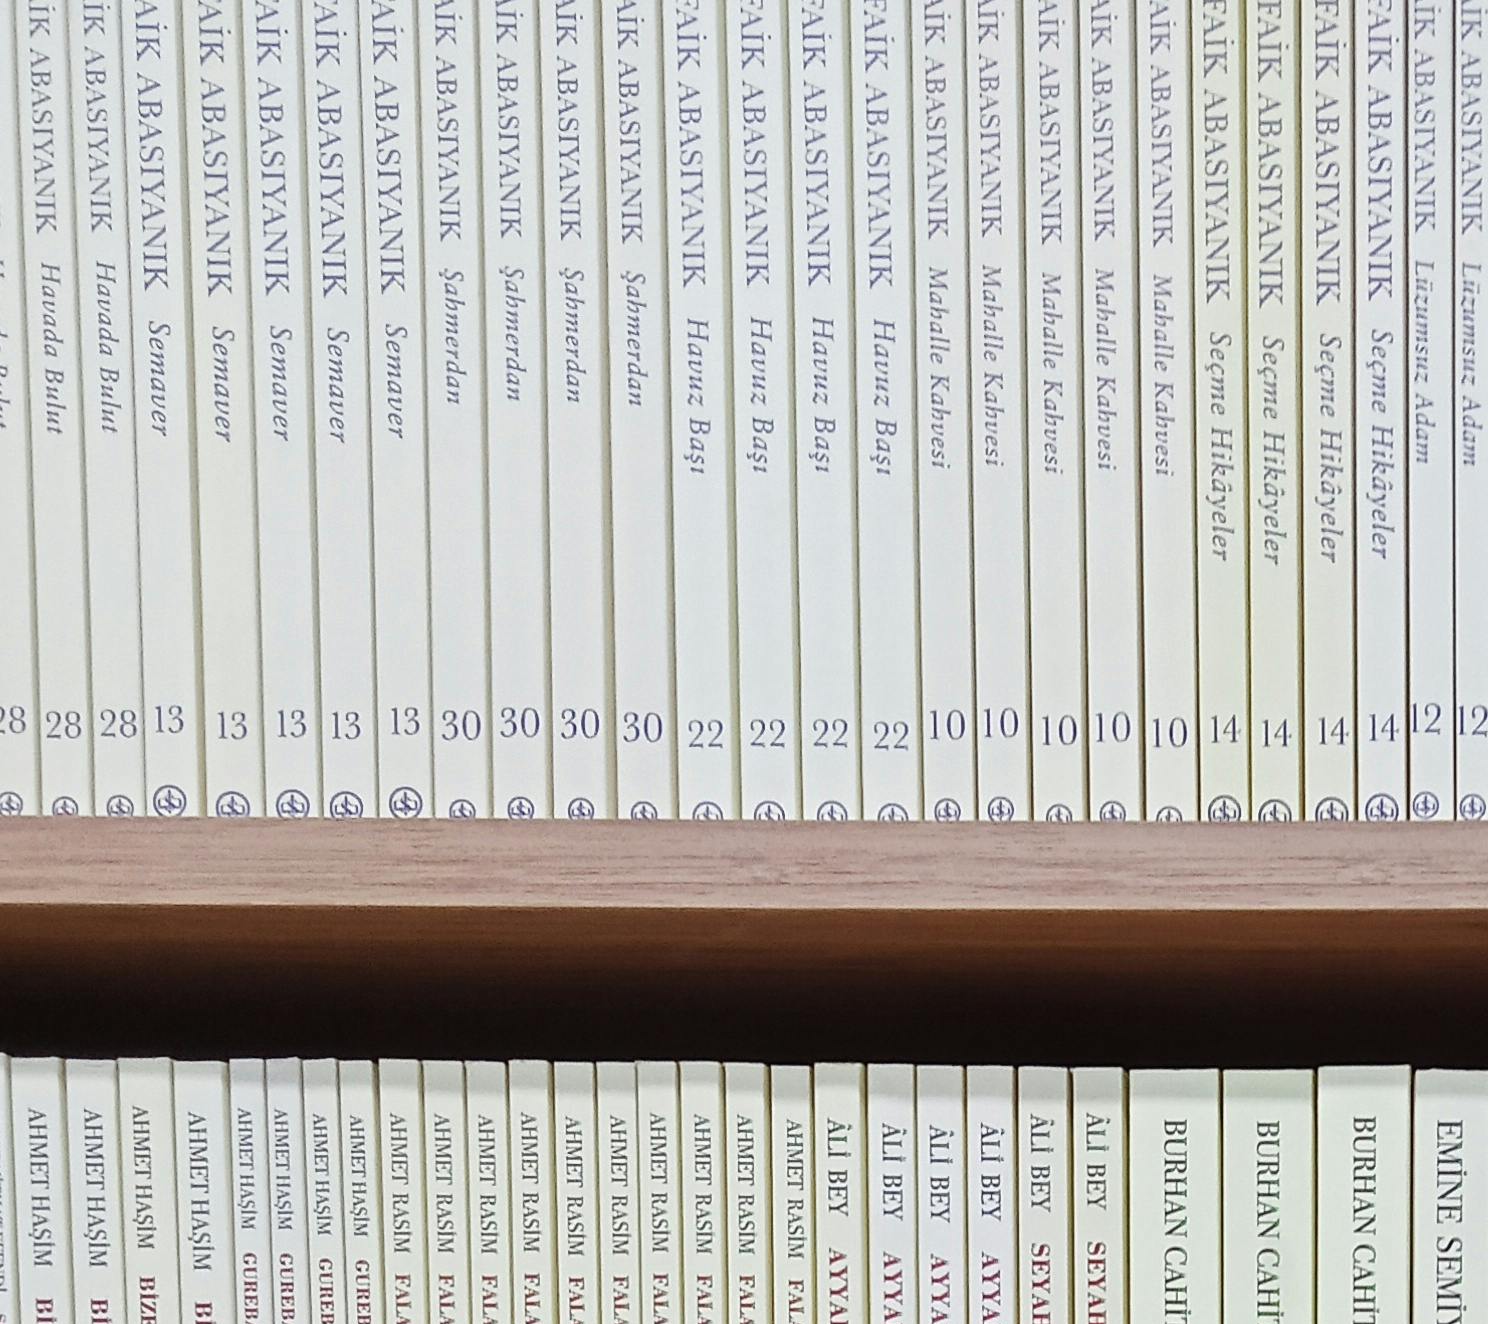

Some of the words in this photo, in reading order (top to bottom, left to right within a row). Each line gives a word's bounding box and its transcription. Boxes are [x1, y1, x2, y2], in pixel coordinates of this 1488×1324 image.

[29, 55, 58, 235] ABASIYANIK
[435, 54, 462, 243] ABASIYANIK
[1257, 91, 1284, 310] ABASIYANIK
[40, 260, 65, 356] Havada
[438, 267, 465, 405] Şahmerdan
[44, 364, 67, 435] Bulut
[1256, 335, 1286, 420] Seçme
[1257, 430, 1288, 567] Hikâyeler
[45, 710, 82, 740] 28
[441, 709, 482, 742] 30
[1261, 718, 1293, 749] 14
[27, 1107, 51, 1191] AHMET
[826, 1116, 849, 1159] ÂLİ
[1255, 1119, 1281, 1241] BURHAN
[1435, 1119, 1468, 1225] EMİNE
[27, 1194, 57, 1267] HAŞİM
[827, 1169, 850, 1218] BEY
